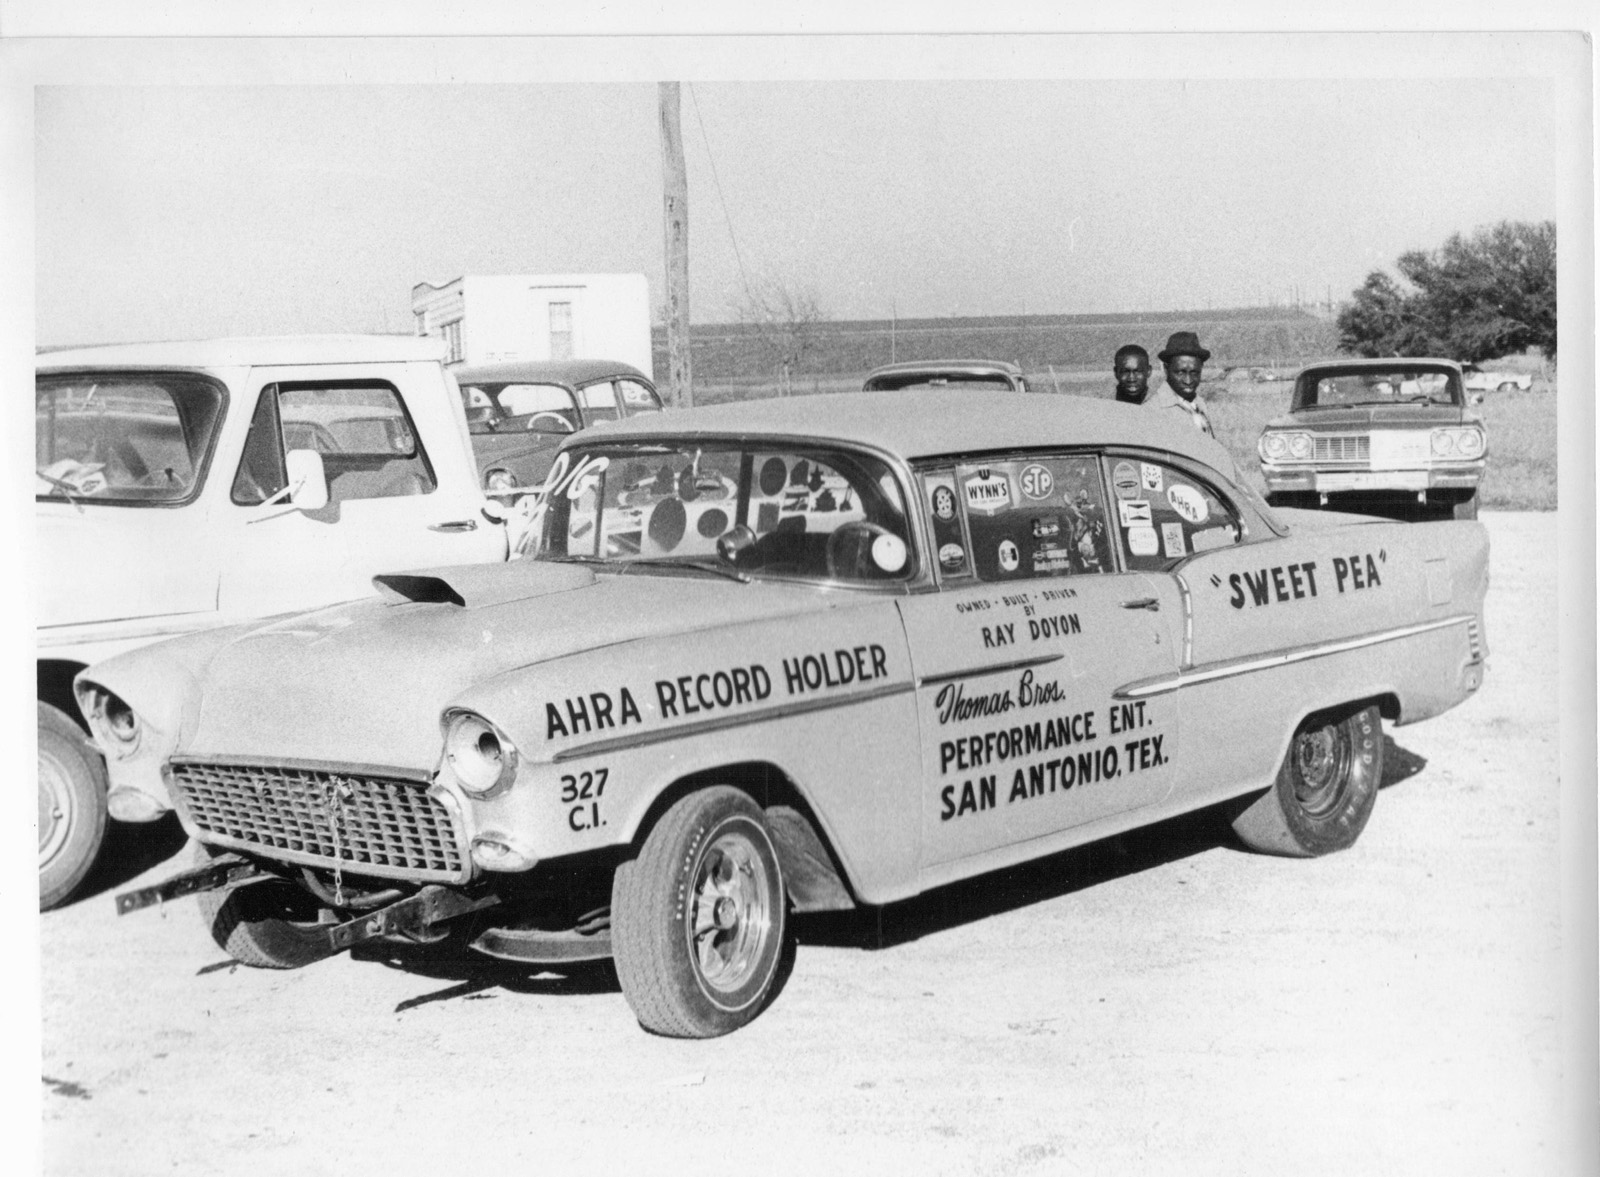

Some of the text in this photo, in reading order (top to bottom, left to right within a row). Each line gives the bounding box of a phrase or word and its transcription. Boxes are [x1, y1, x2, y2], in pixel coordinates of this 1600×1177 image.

[967, 482, 1007, 500] WYNN'S
[1022, 467, 1051, 496] STP
[1170, 490, 1198, 521] AHRA
[956, 588, 1079, 614] OWNED BUILT DRIVEN
[1023, 604, 1036, 617] BY
[981, 613, 1082, 649] RAY DOYON
[545, 644, 888, 740] AHRA RECORD HOLDER
[935, 669, 1066, 725] Thomas Bros.
[940, 700, 1153, 775] PERFORMANCE ENT.
[560, 768, 610, 803] 327
[940, 774, 997, 821] SAN
[1125, 734, 1169, 773] TEX.
[568, 802, 608, 832] C.I.
